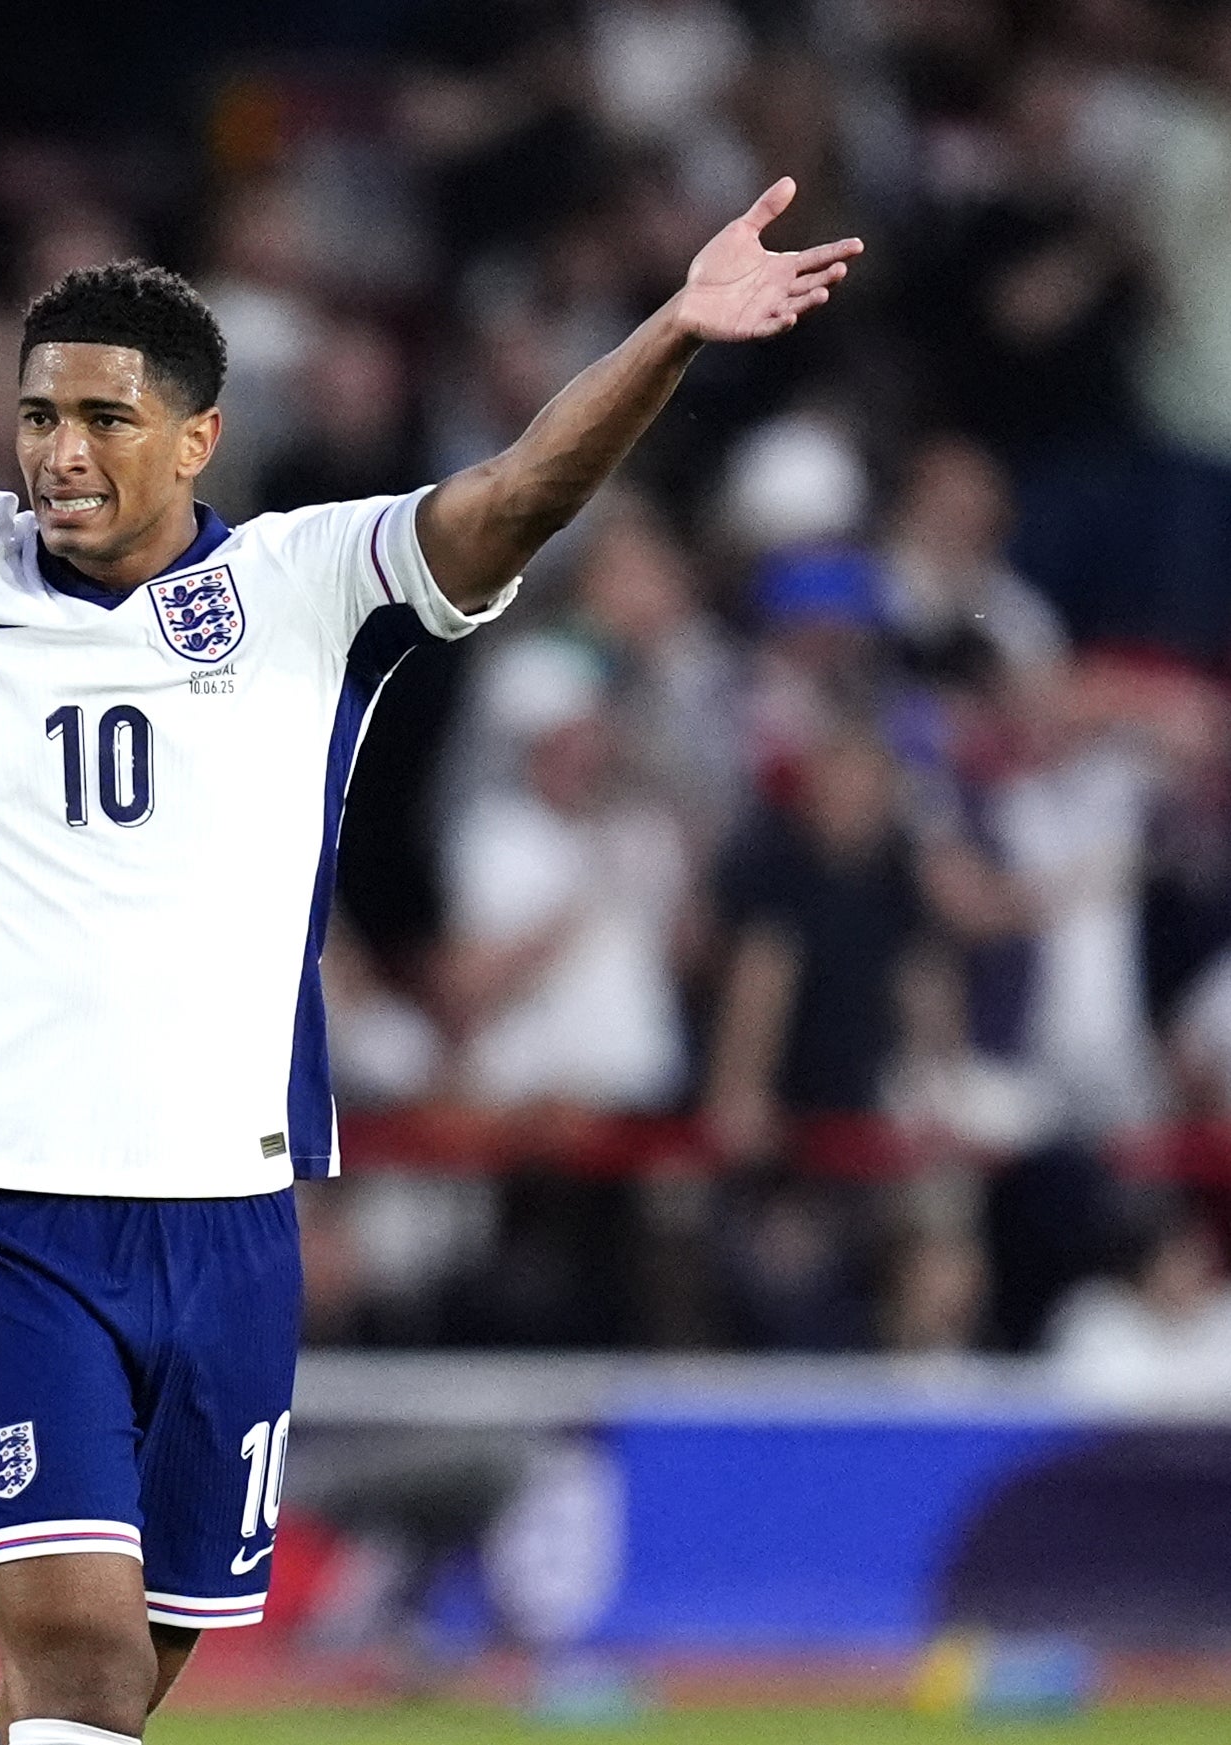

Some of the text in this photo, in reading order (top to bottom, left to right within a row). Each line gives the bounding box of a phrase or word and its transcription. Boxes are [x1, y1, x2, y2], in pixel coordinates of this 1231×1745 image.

[189, 680, 234, 694] 10.06.25
[45, 705, 155, 828] 10
[241, 1410, 290, 1538] 10
